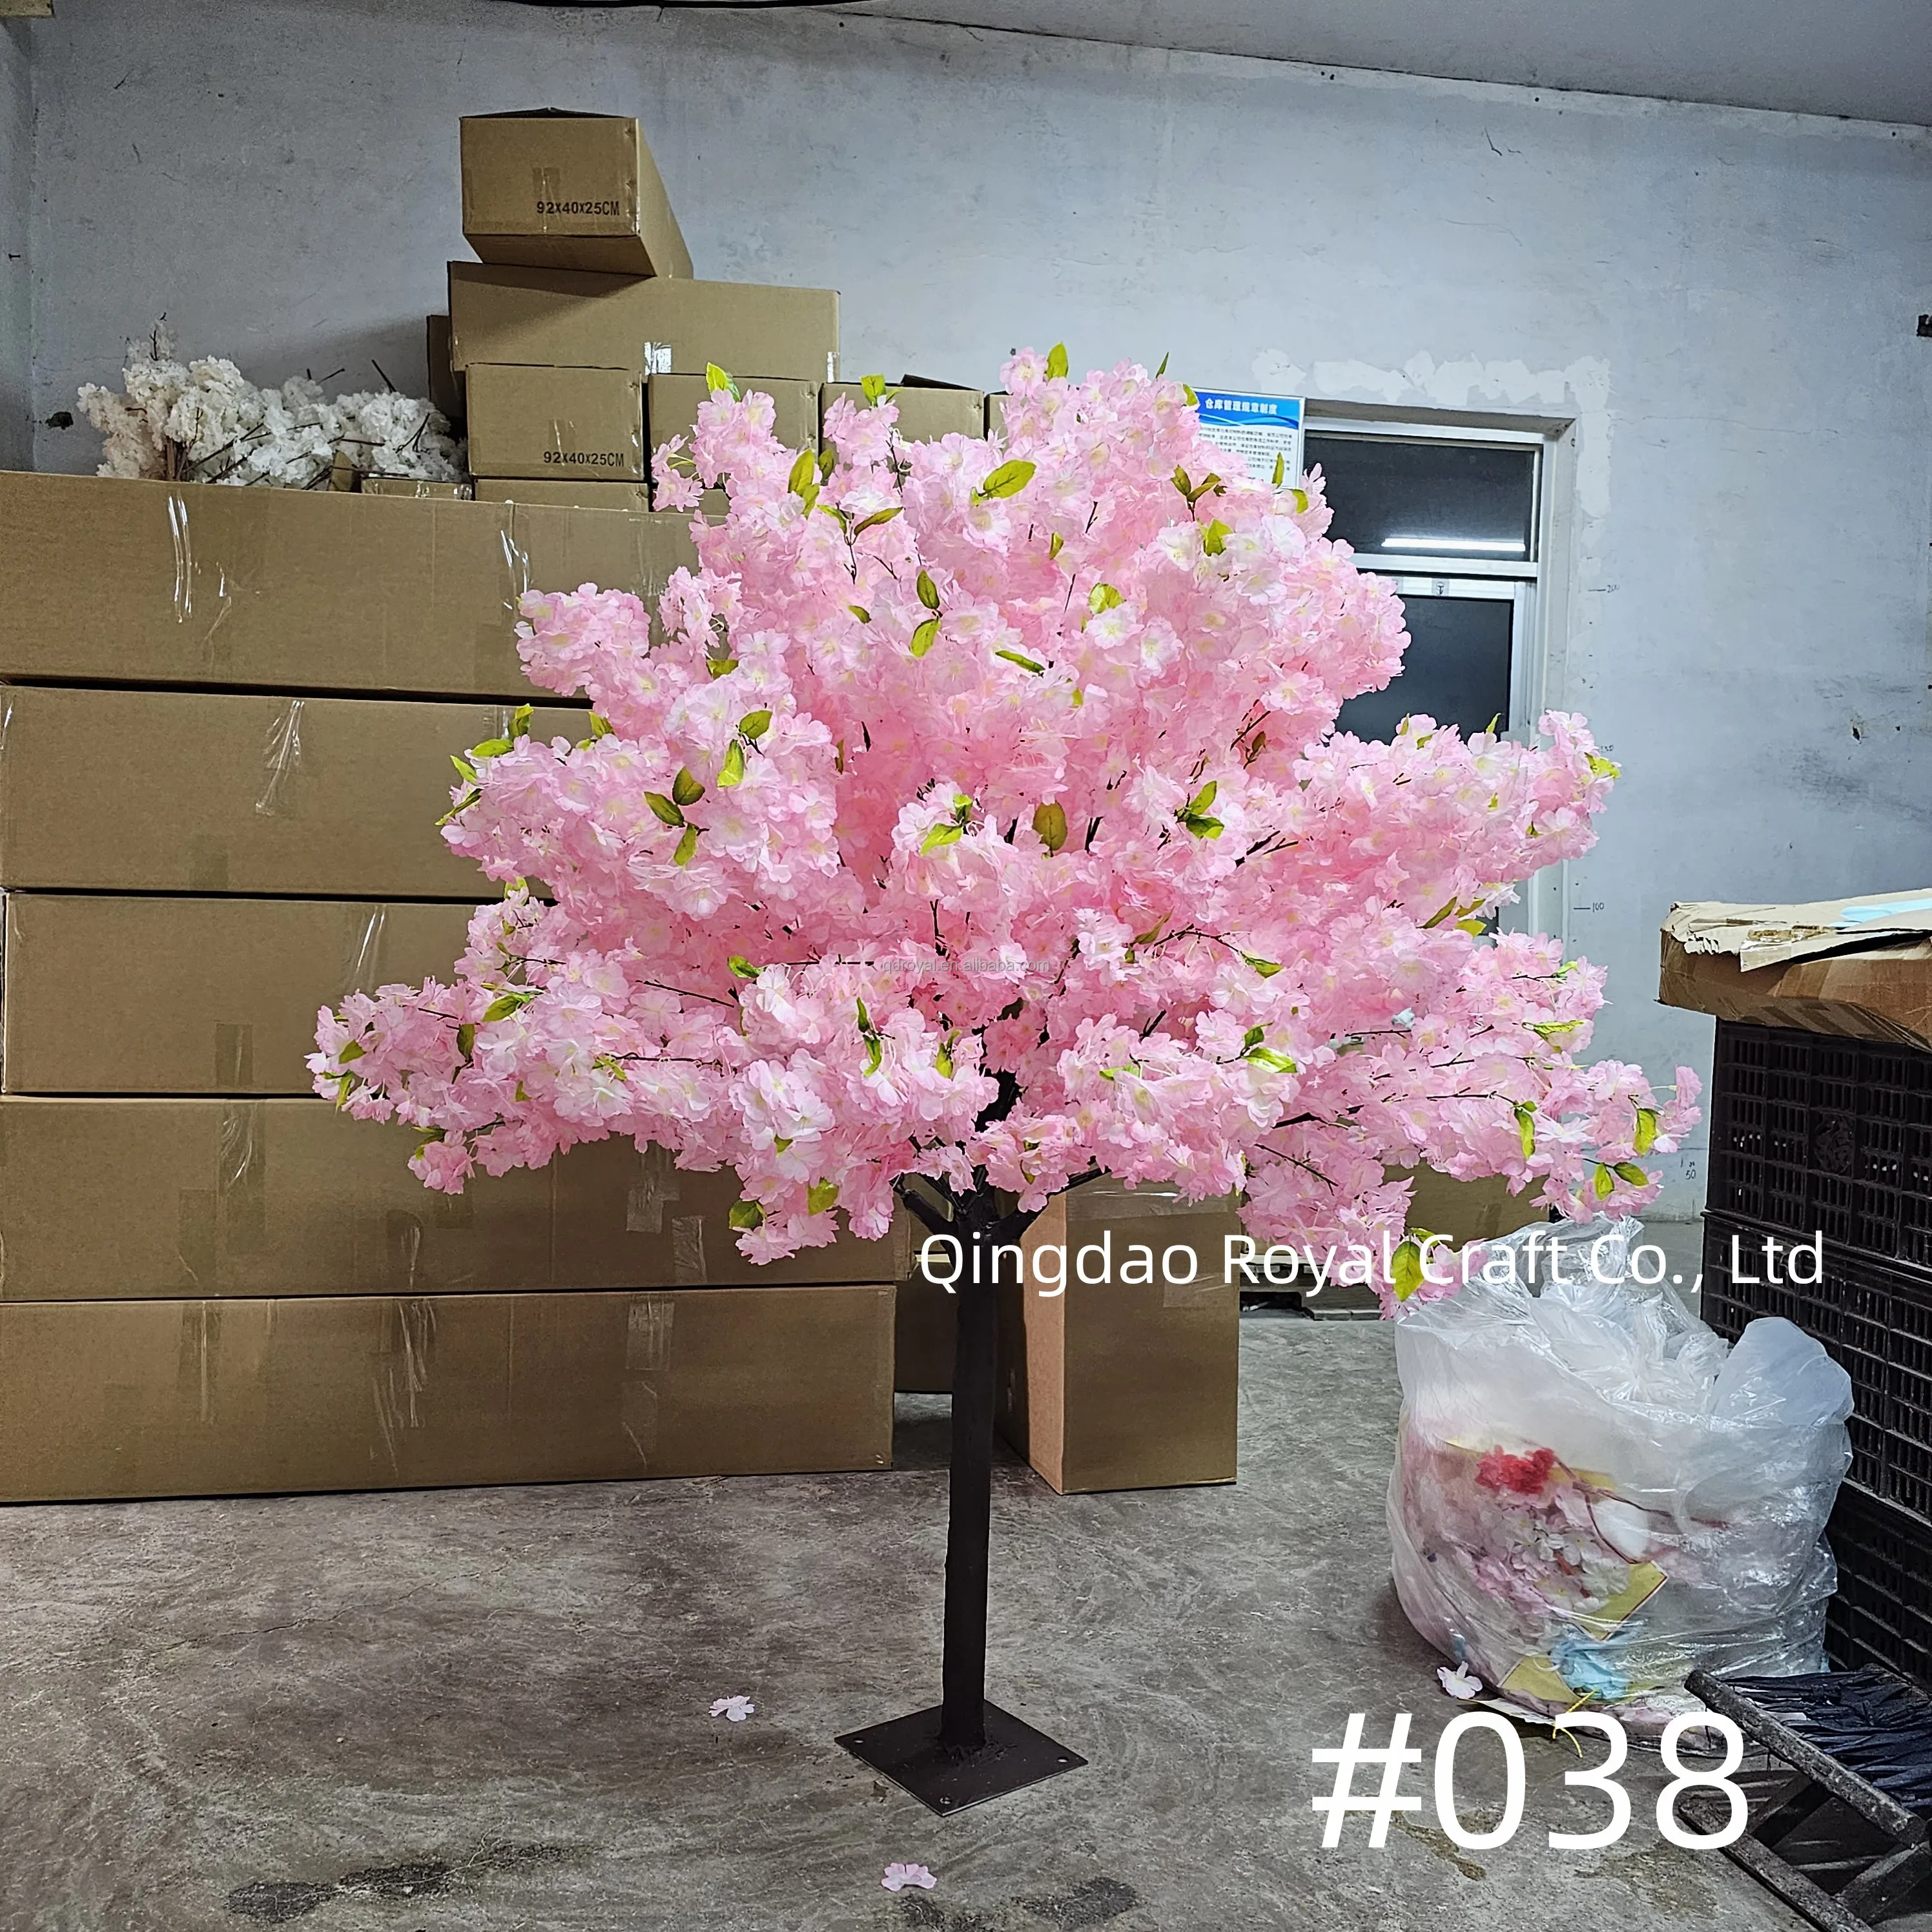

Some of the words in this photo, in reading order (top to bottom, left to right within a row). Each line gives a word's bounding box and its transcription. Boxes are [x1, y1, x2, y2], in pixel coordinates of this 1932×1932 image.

[1205, 397, 1278, 415] 仓库管理规章制度
[1592, 901, 1605, 913] 100
[1685, 1169, 1696, 1180] 50
